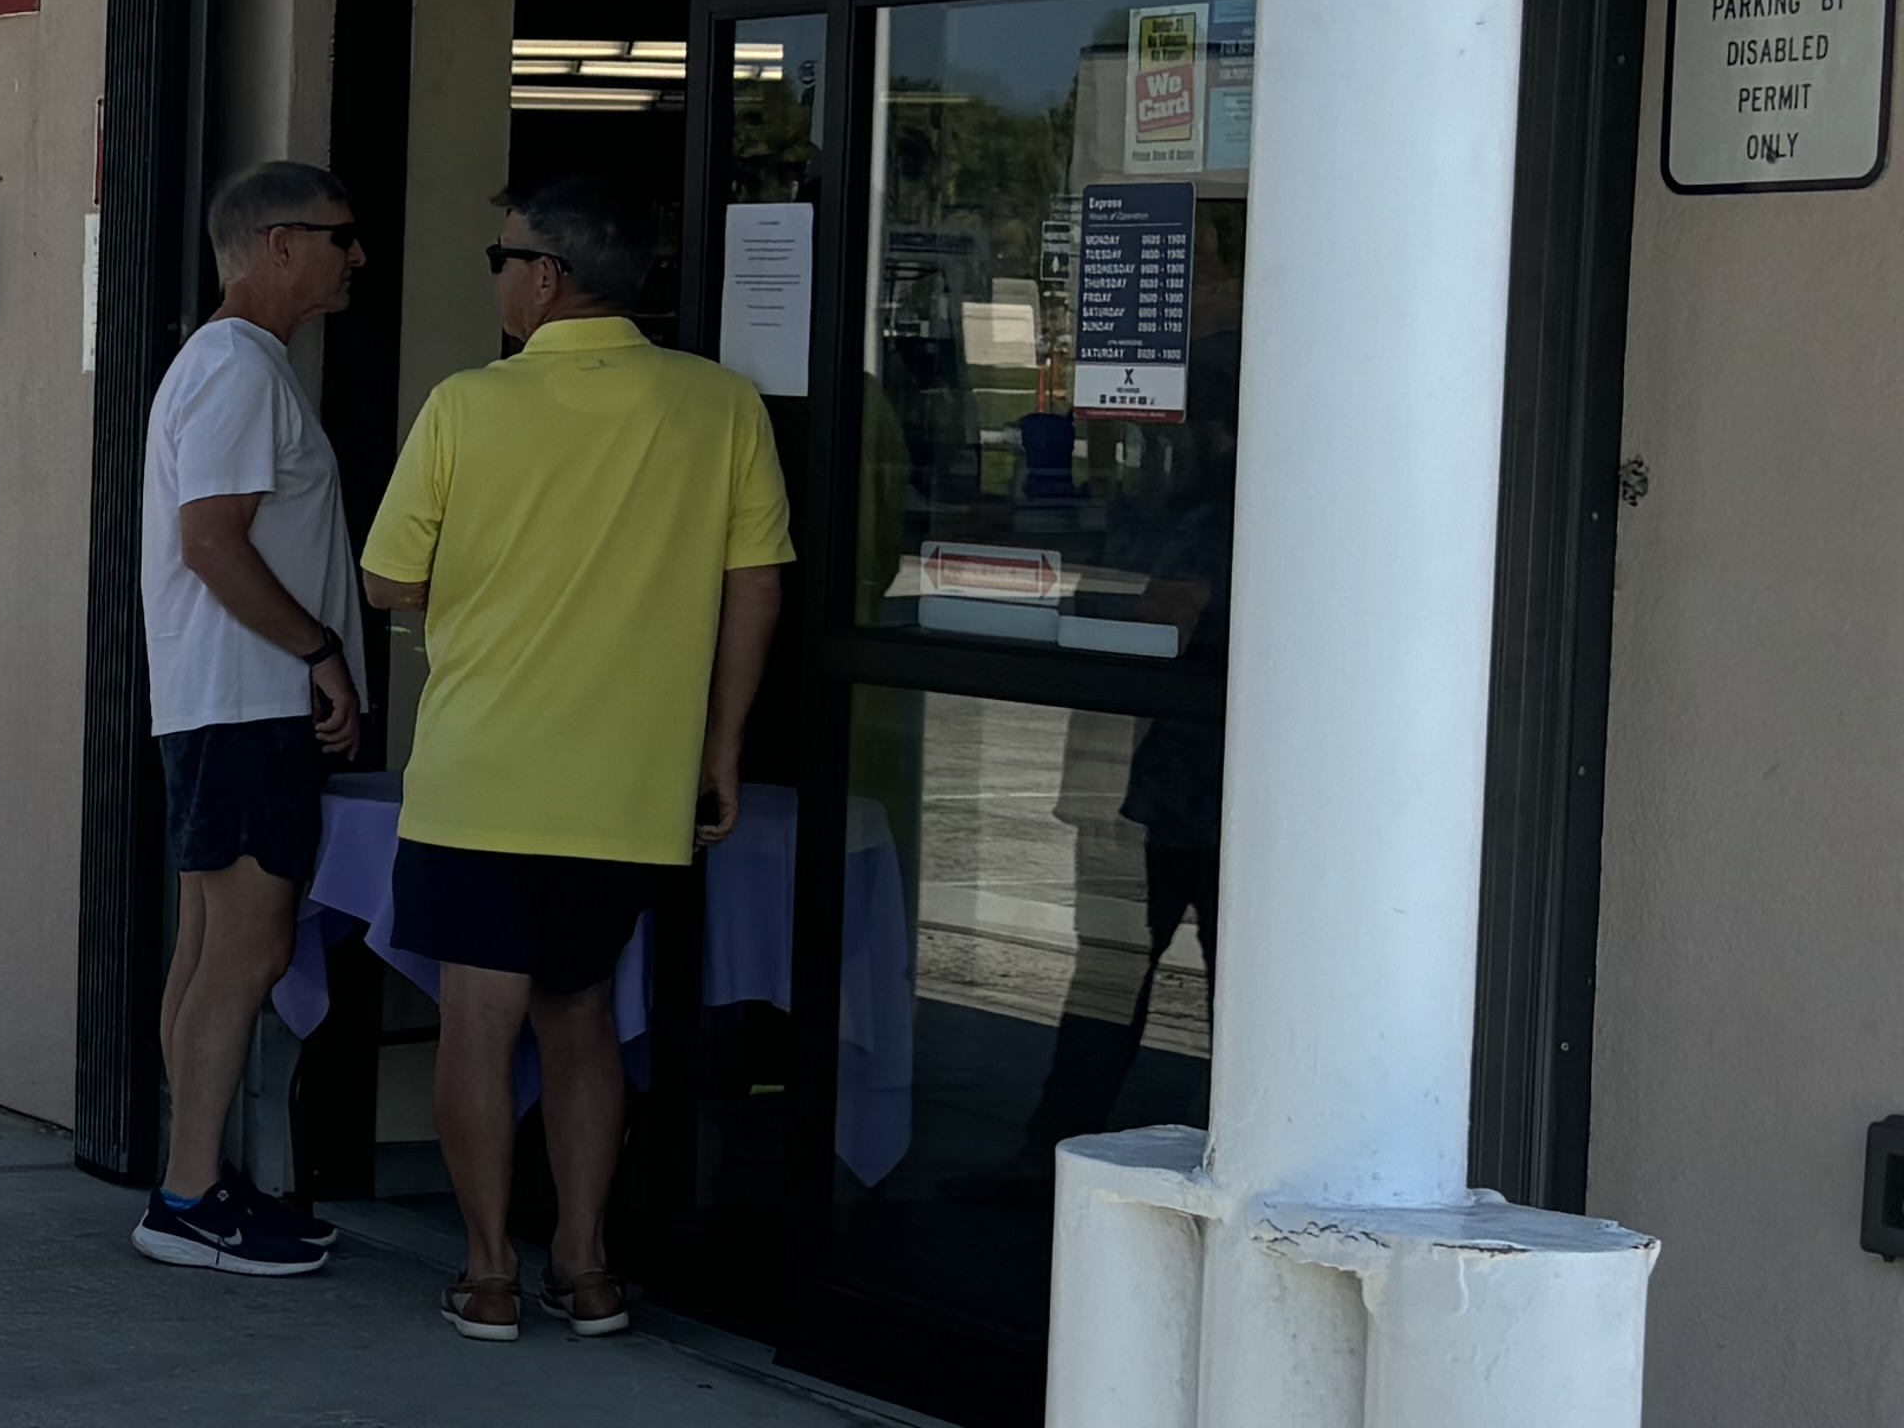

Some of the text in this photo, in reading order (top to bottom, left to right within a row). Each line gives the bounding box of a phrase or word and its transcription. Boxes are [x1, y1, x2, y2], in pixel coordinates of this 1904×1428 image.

[1727, 34, 1829, 66] DISABLED
[1146, 73, 1182, 98] We
[1738, 83, 1812, 113] PERMIT
[1138, 90, 1190, 122] Card
[1747, 132, 1799, 160] ONLY
[1085, 235, 1120, 245] MONDAY
[1085, 249, 1122, 260] TUESDAY
[1084, 278, 1127, 288] THURSDAY
[1083, 292, 1111, 303] FRIDAY
